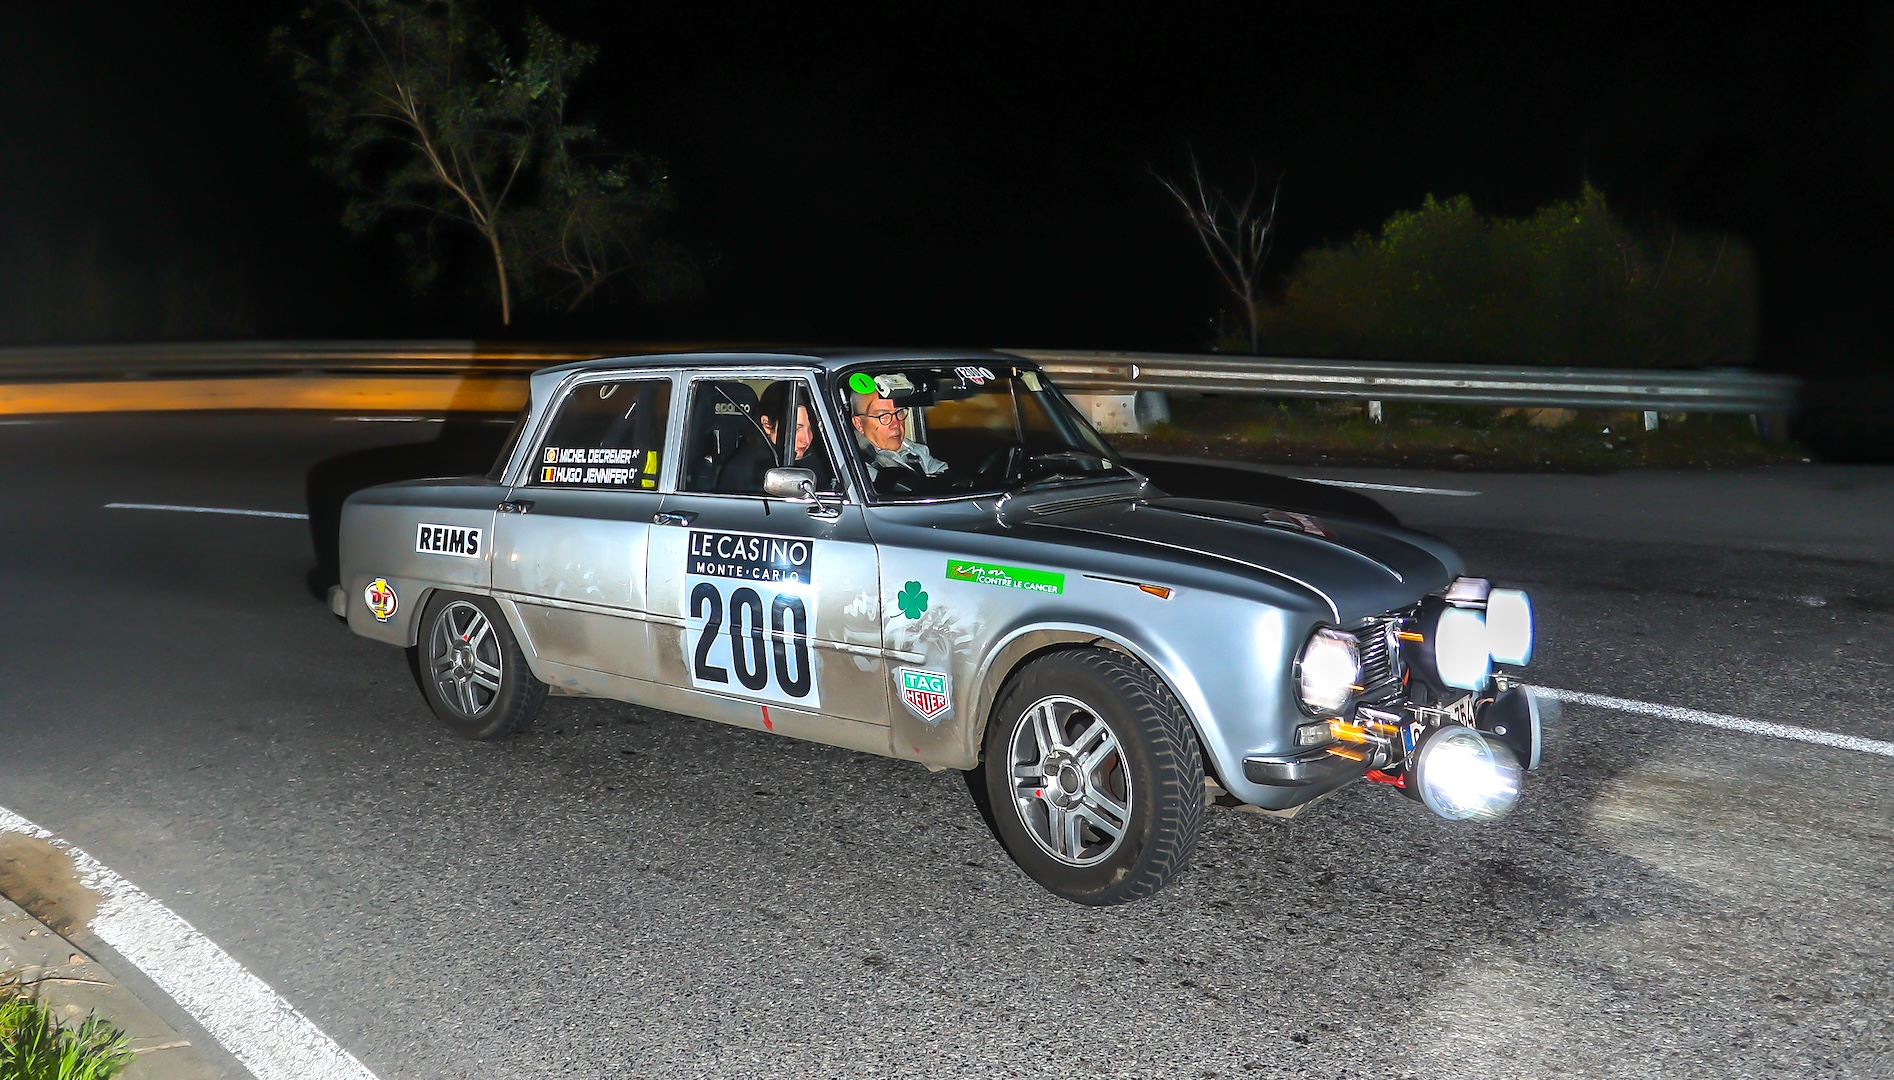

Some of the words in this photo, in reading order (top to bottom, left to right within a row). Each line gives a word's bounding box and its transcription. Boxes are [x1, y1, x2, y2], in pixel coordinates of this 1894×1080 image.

[559, 448, 586, 463] MICHEL
[587, 449, 632, 464] DECREMER
[556, 467, 582, 483] HUGO
[582, 468, 628, 484] JENNIFER
[419, 526, 479, 555] REIMS
[691, 533, 713, 557] LE
[717, 536, 808, 566] CASINO
[978, 576, 1011, 587] CONTRE
[1024, 582, 1058, 593] CANCER
[690, 582, 812, 698] 200
[906, 673, 942, 692] TAG
[906, 690, 945, 714] HEUER
